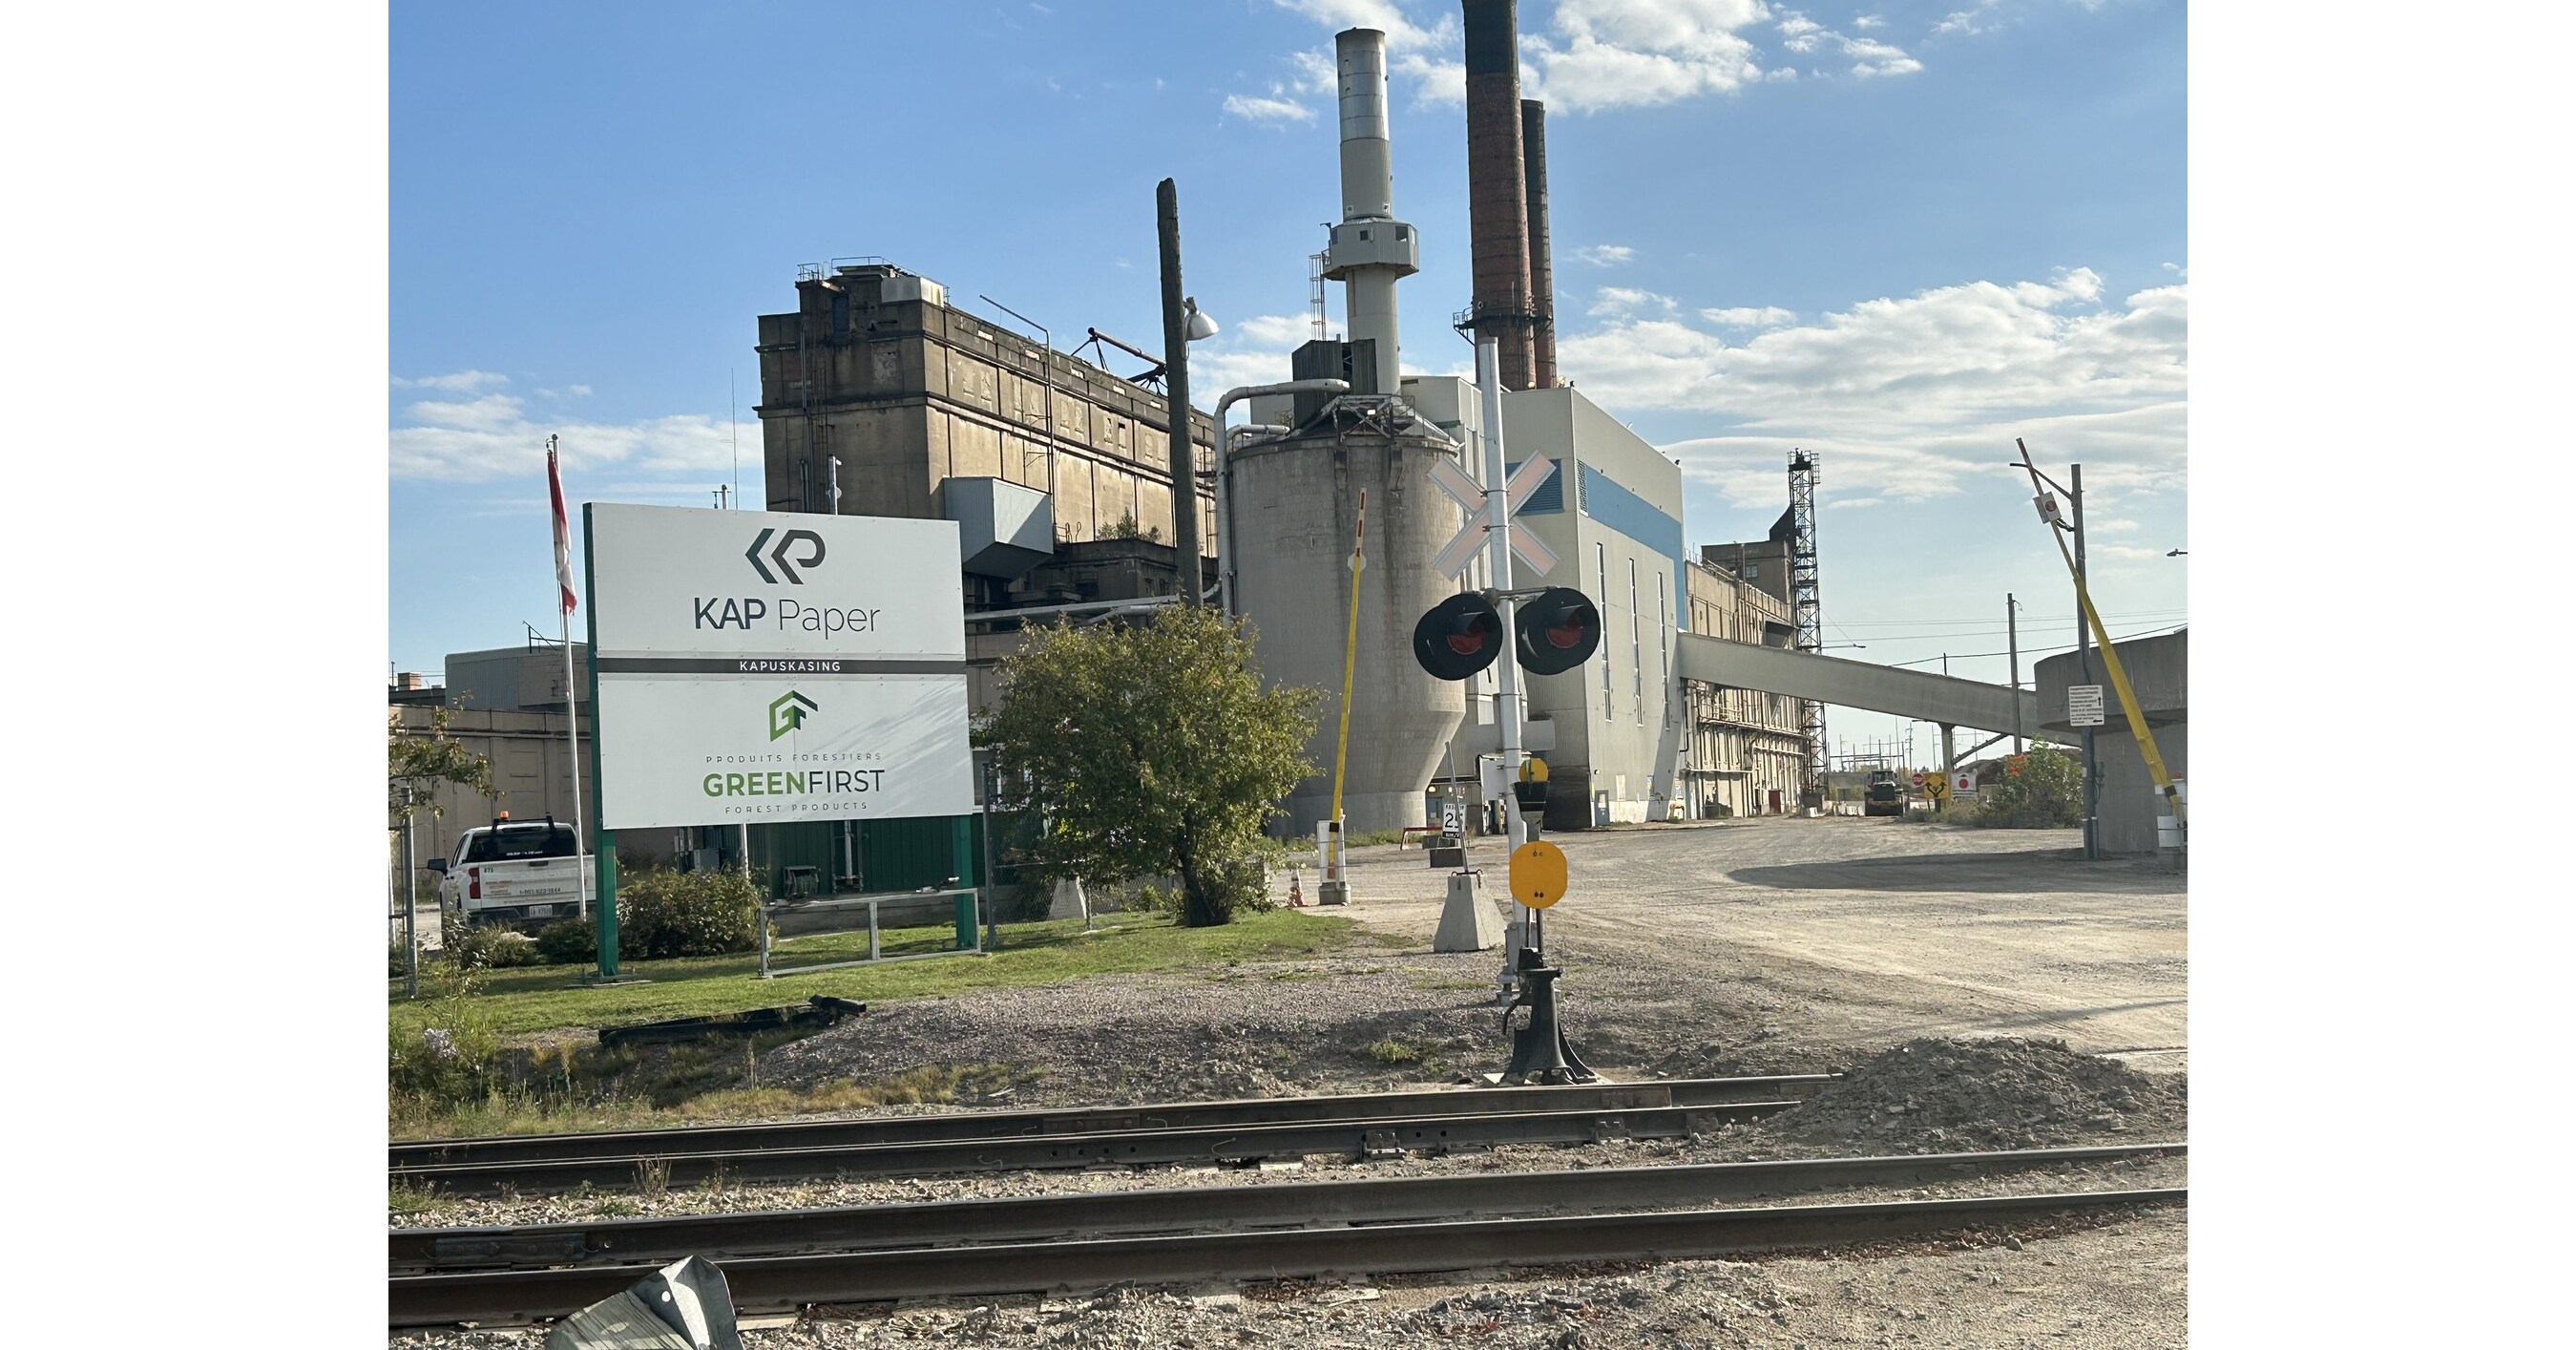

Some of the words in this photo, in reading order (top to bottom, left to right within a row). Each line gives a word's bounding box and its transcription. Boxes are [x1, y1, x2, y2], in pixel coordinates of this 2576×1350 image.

[694, 597, 766, 630] KAP
[779, 599, 881, 640] Paper
[740, 660, 841, 672] KAPUSKASING
[706, 754, 782, 763] PRODUITS
[792, 752, 882, 762] FORESTIERS
[702, 770, 886, 797] GREENFIRST
[724, 805, 782, 814] FOREST
[792, 802, 868, 812] PRODUCTS
